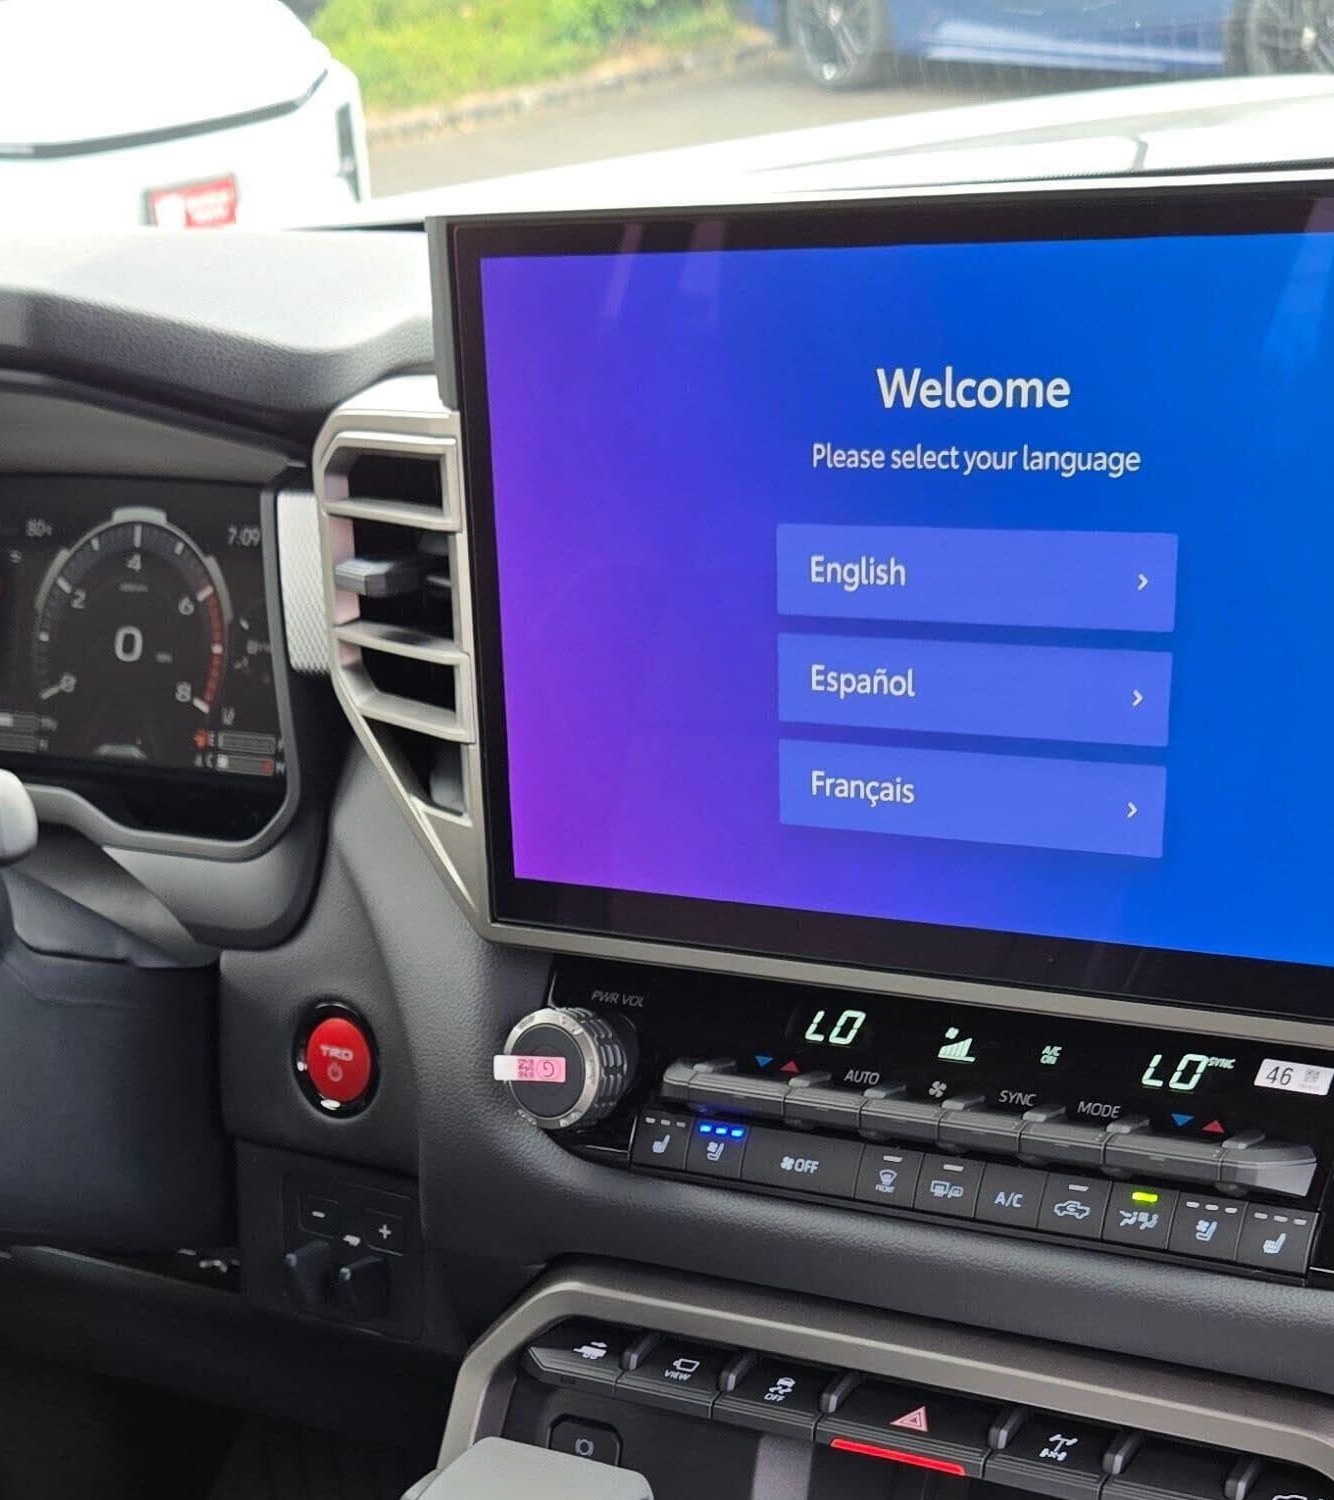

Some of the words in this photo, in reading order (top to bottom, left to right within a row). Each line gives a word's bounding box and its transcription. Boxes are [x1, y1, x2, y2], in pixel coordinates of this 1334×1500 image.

[876, 366, 1070, 409] Welcome
[812, 444, 885, 470] Please
[891, 445, 958, 470] select
[963, 449, 1017, 475] your
[1023, 446, 1140, 477] language
[810, 555, 906, 592] English
[114, 625, 143, 662] 0
[811, 664, 916, 700] Español
[811, 770, 915, 807] Français
[591, 990, 620, 1004] PWR
[622, 994, 645, 1007] VOL
[319, 1044, 354, 1061] TRD
[1042, 1045, 1062, 1056] A/C
[844, 1069, 880, 1086] AUTO
[1266, 1066, 1294, 1086] 46
[998, 1089, 1037, 1108] SYNC
[1077, 1101, 1121, 1119] MODE
[794, 1158, 819, 1174] OFF
[994, 1192, 1023, 1208] A/C
[664, 1370, 692, 1381] VIEW
[764, 1393, 785, 1402] OFF
